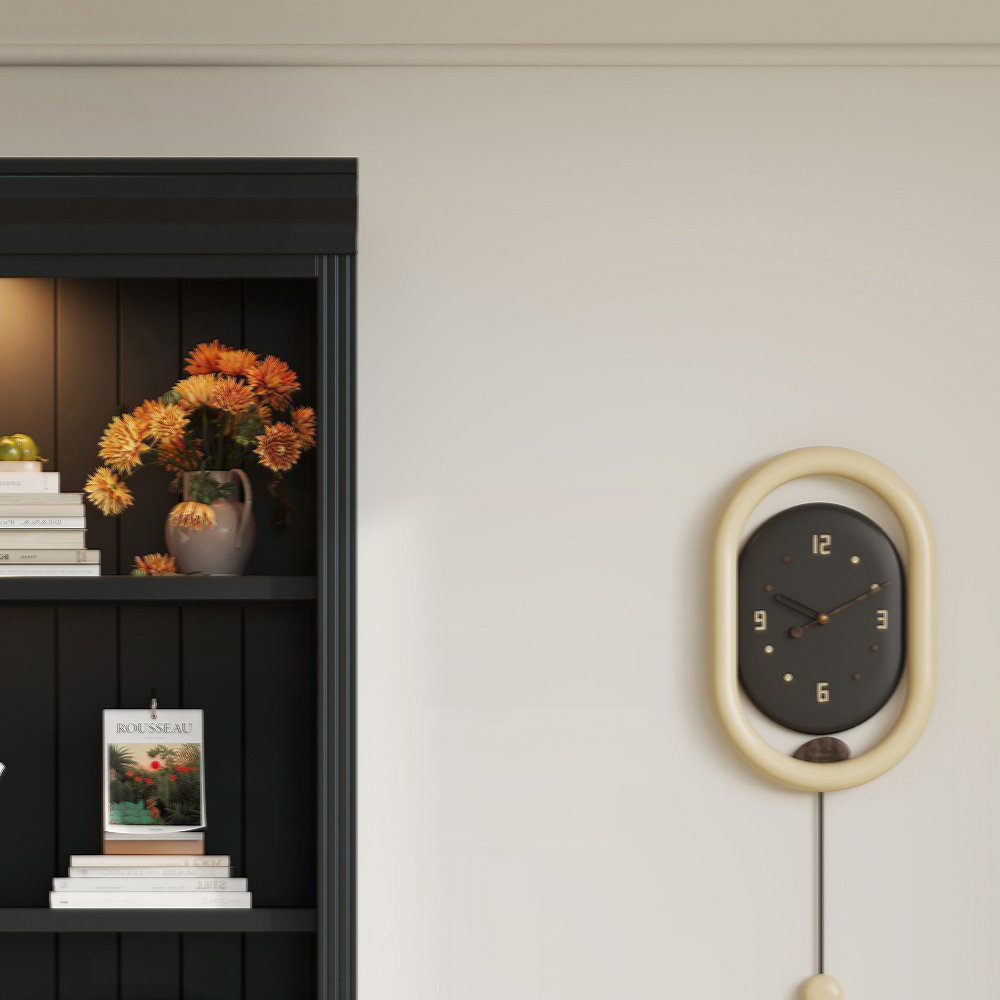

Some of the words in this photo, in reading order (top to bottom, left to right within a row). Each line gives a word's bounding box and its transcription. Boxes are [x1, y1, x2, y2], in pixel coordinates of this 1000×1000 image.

[811, 534, 832, 555] 12
[753, 610, 767, 631] 9
[875, 610, 889, 629] 3
[815, 682, 830, 702] 6
[116, 722, 193, 734] ROUSSEAU
